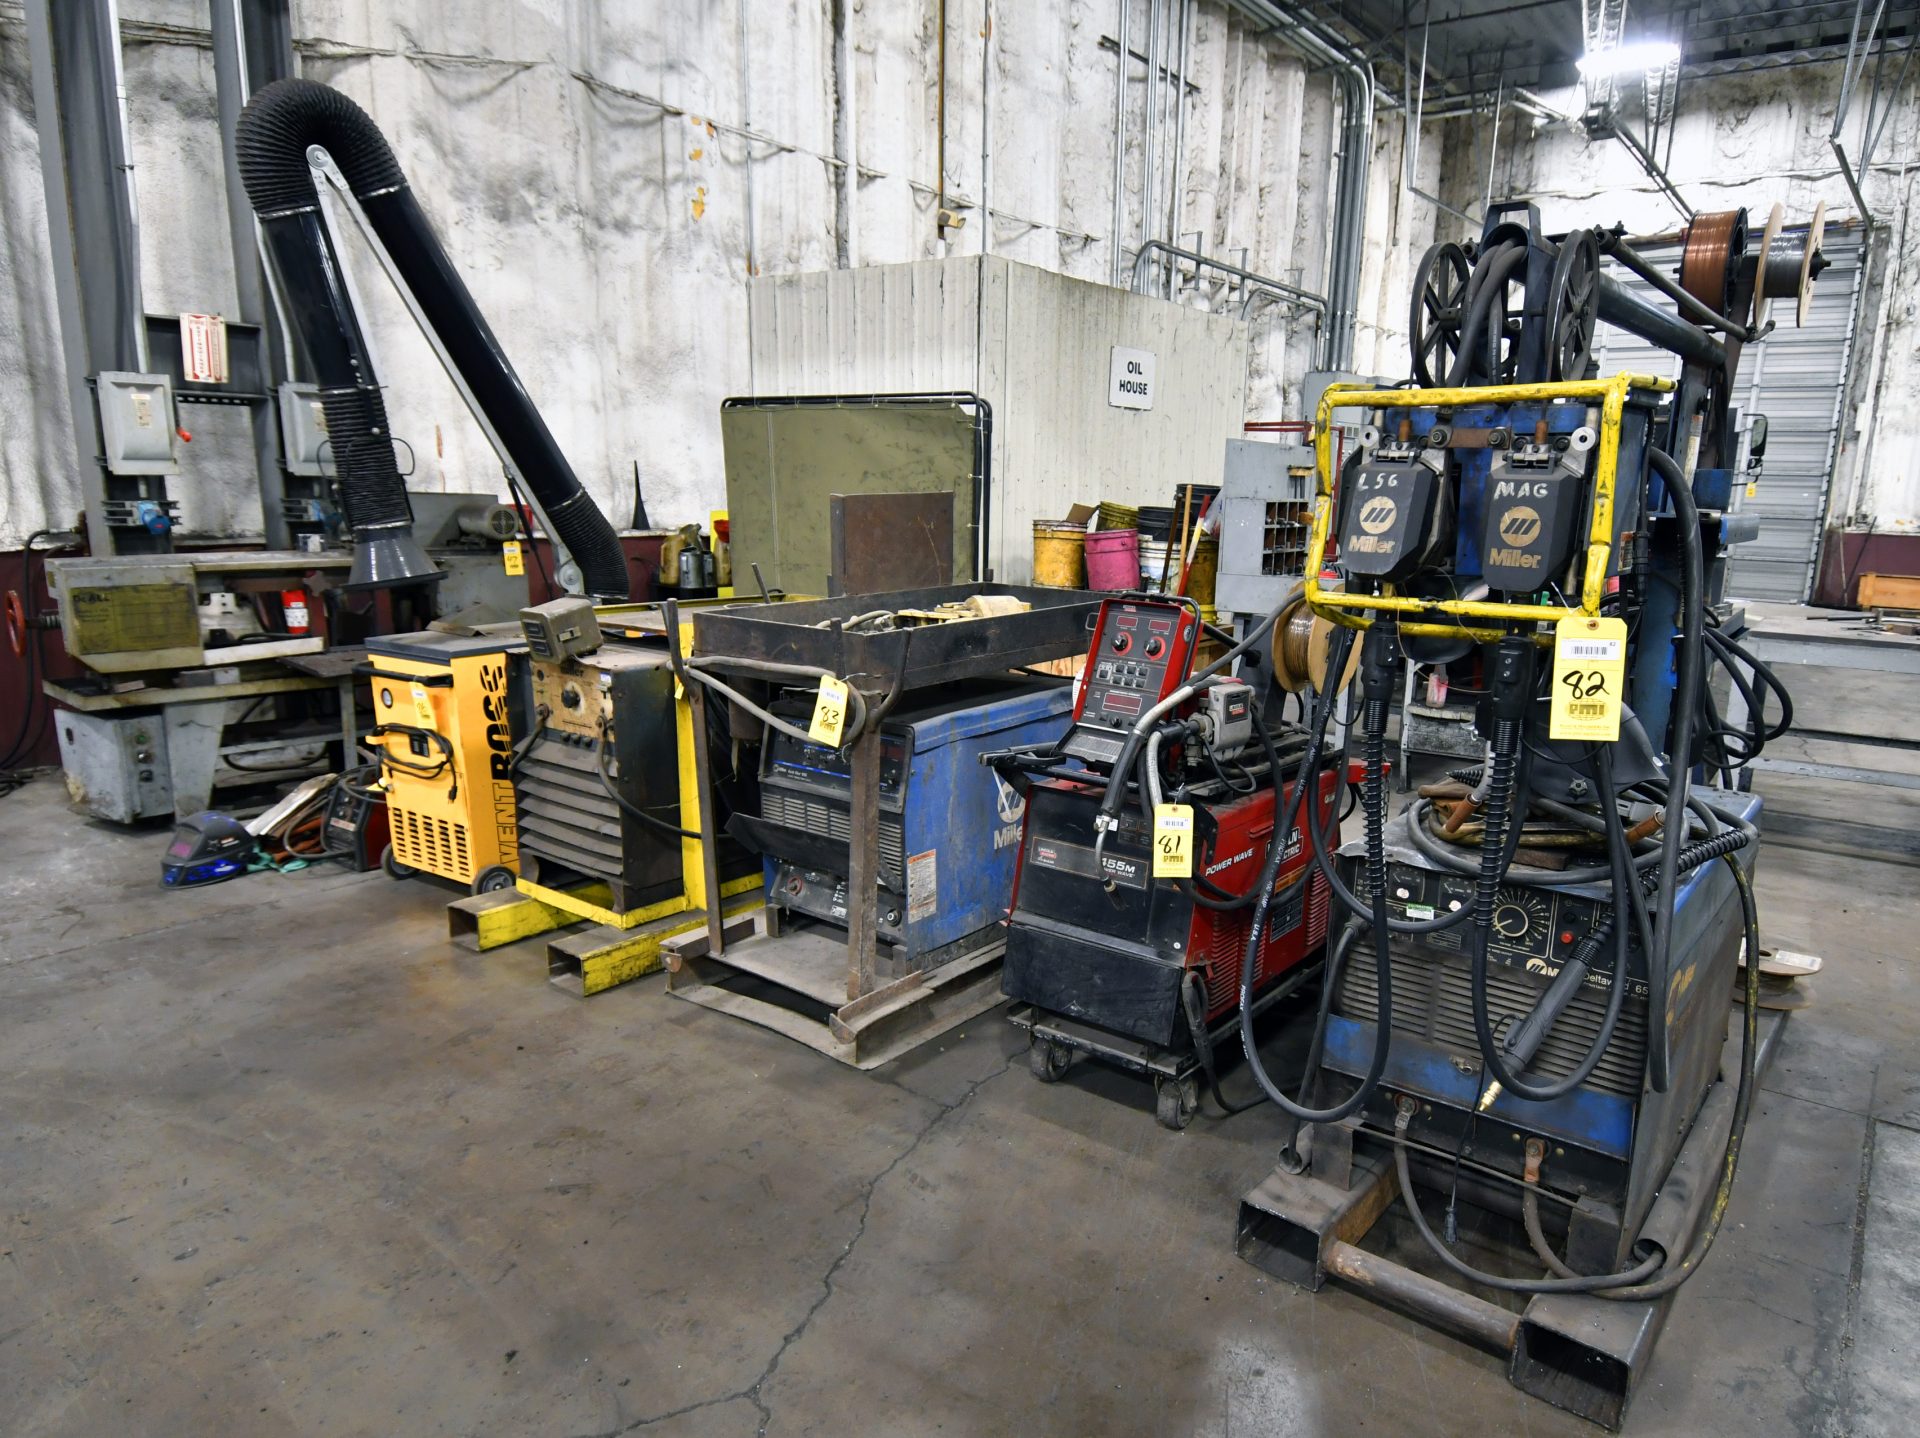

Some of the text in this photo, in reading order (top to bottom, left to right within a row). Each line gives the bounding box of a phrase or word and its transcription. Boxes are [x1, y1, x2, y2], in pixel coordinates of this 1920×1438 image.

[1127, 360, 1143, 375] OIL
[1119, 379, 1148, 395] HOUSE
[1493, 480, 1549, 500] MAG
[1349, 534, 1396, 554] Miller
[1489, 547, 1541, 569] Miller
[1562, 670, 1610, 699] 82
[821, 705, 839, 725] 83
[993, 823, 1023, 850] Mille
[1158, 834, 1181, 854] 81
[1205, 857, 1232, 877] POWER
[1233, 847, 1255, 863] WAVE
[1261, 892, 1269, 908] AMP
[1583, 972, 1629, 990] Deltawd
